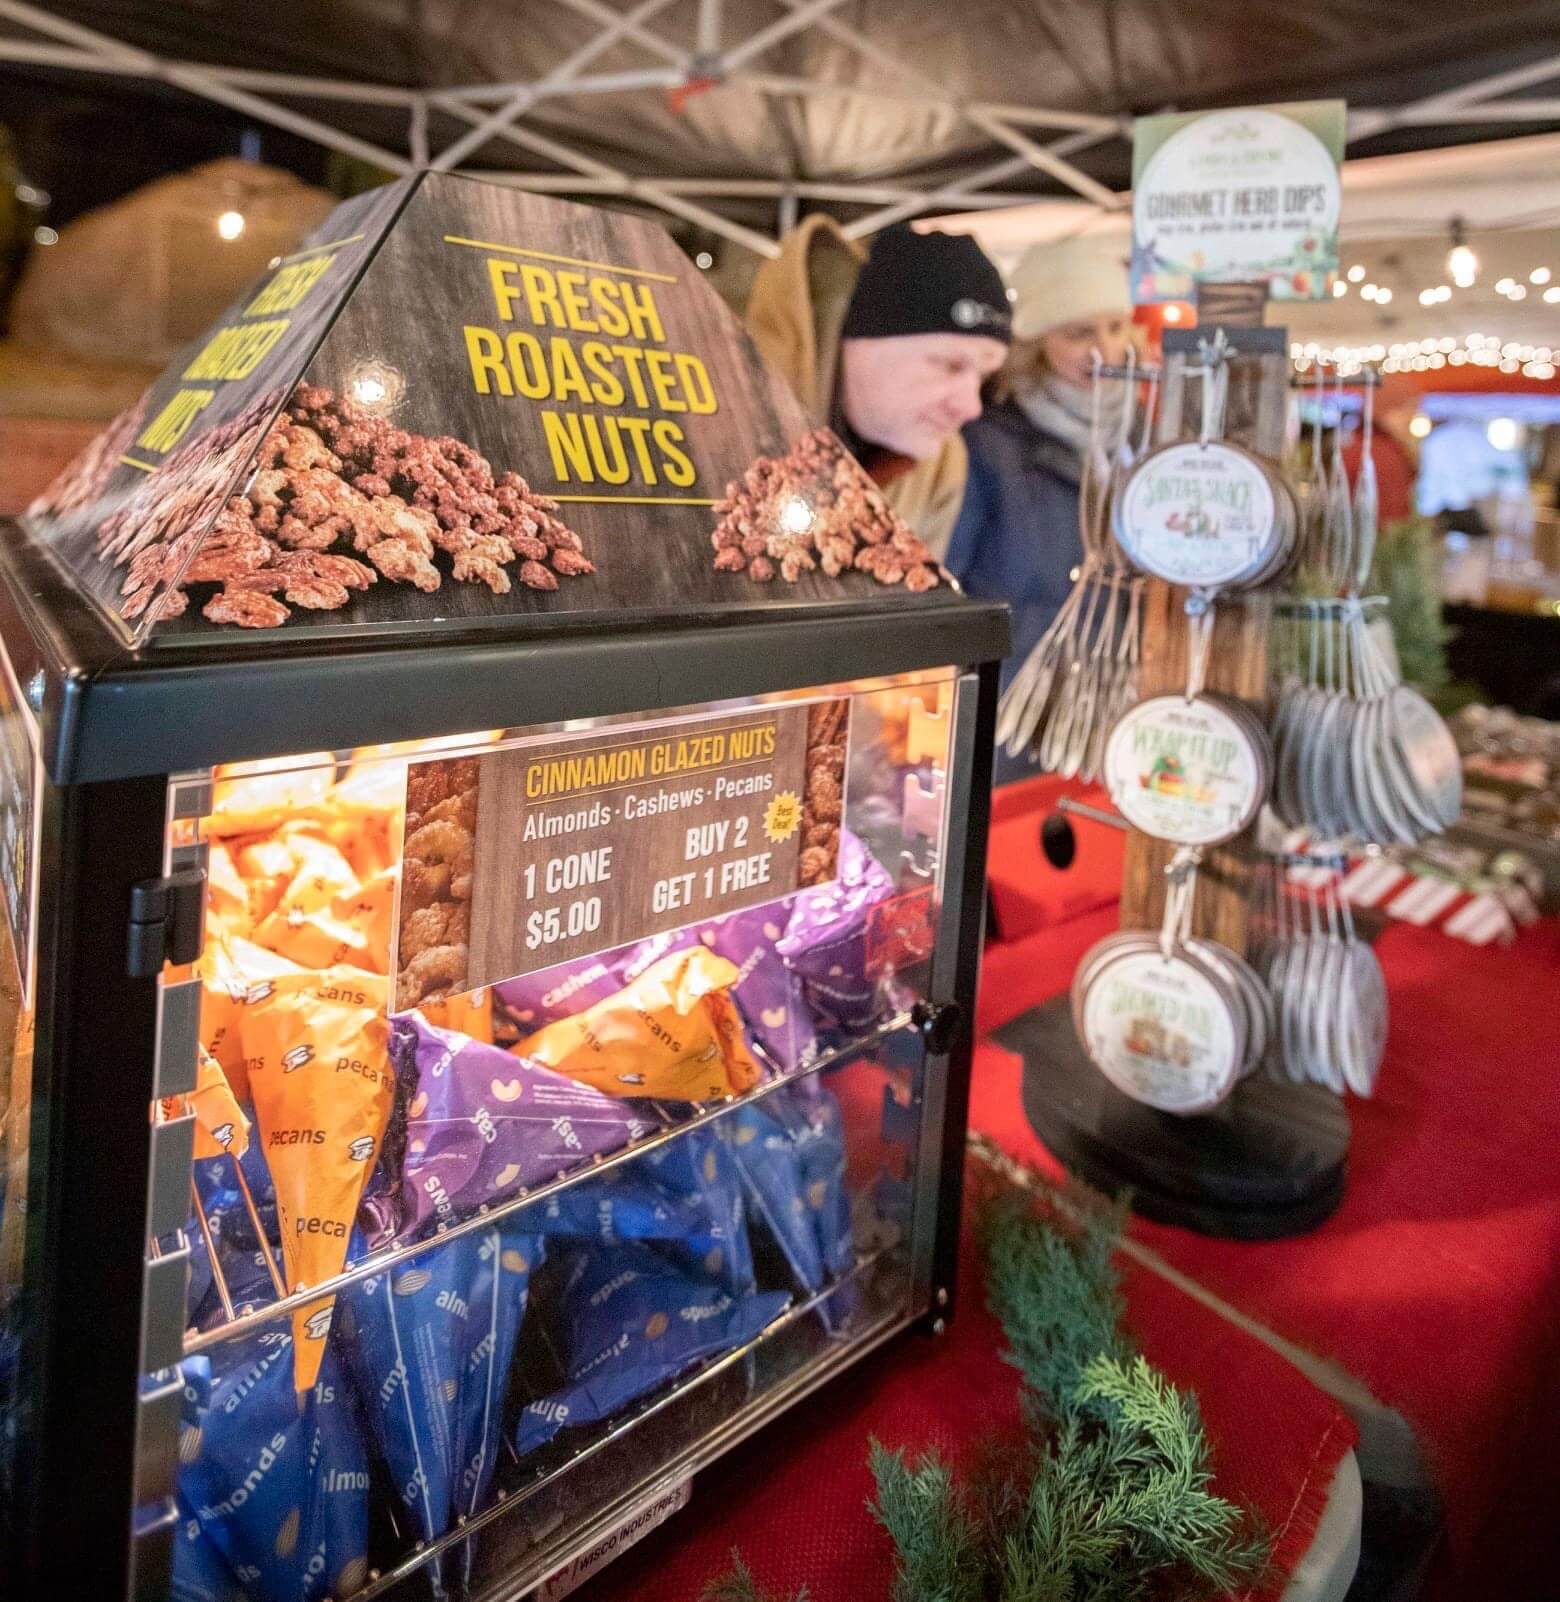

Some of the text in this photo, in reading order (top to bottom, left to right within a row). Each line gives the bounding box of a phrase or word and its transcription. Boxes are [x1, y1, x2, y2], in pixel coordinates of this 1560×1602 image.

[1284, 183, 1327, 213] DIPS
[487, 258, 667, 342] FRESH
[464, 325, 719, 415] ROASTED
[541, 410, 697, 488] NUTS
[526, 725, 776, 798] CINNAMON GLAZED NUTS
[522, 773, 773, 842] Almonds Cashews Pecans
[685, 815, 749, 861] BUY 2
[524, 846, 613, 900] 1 CONE
[653, 852, 772, 914] GET 1 FREE
[526, 896, 602, 950] $5.00
[619, 1486, 682, 1540] INDUSTRIES
